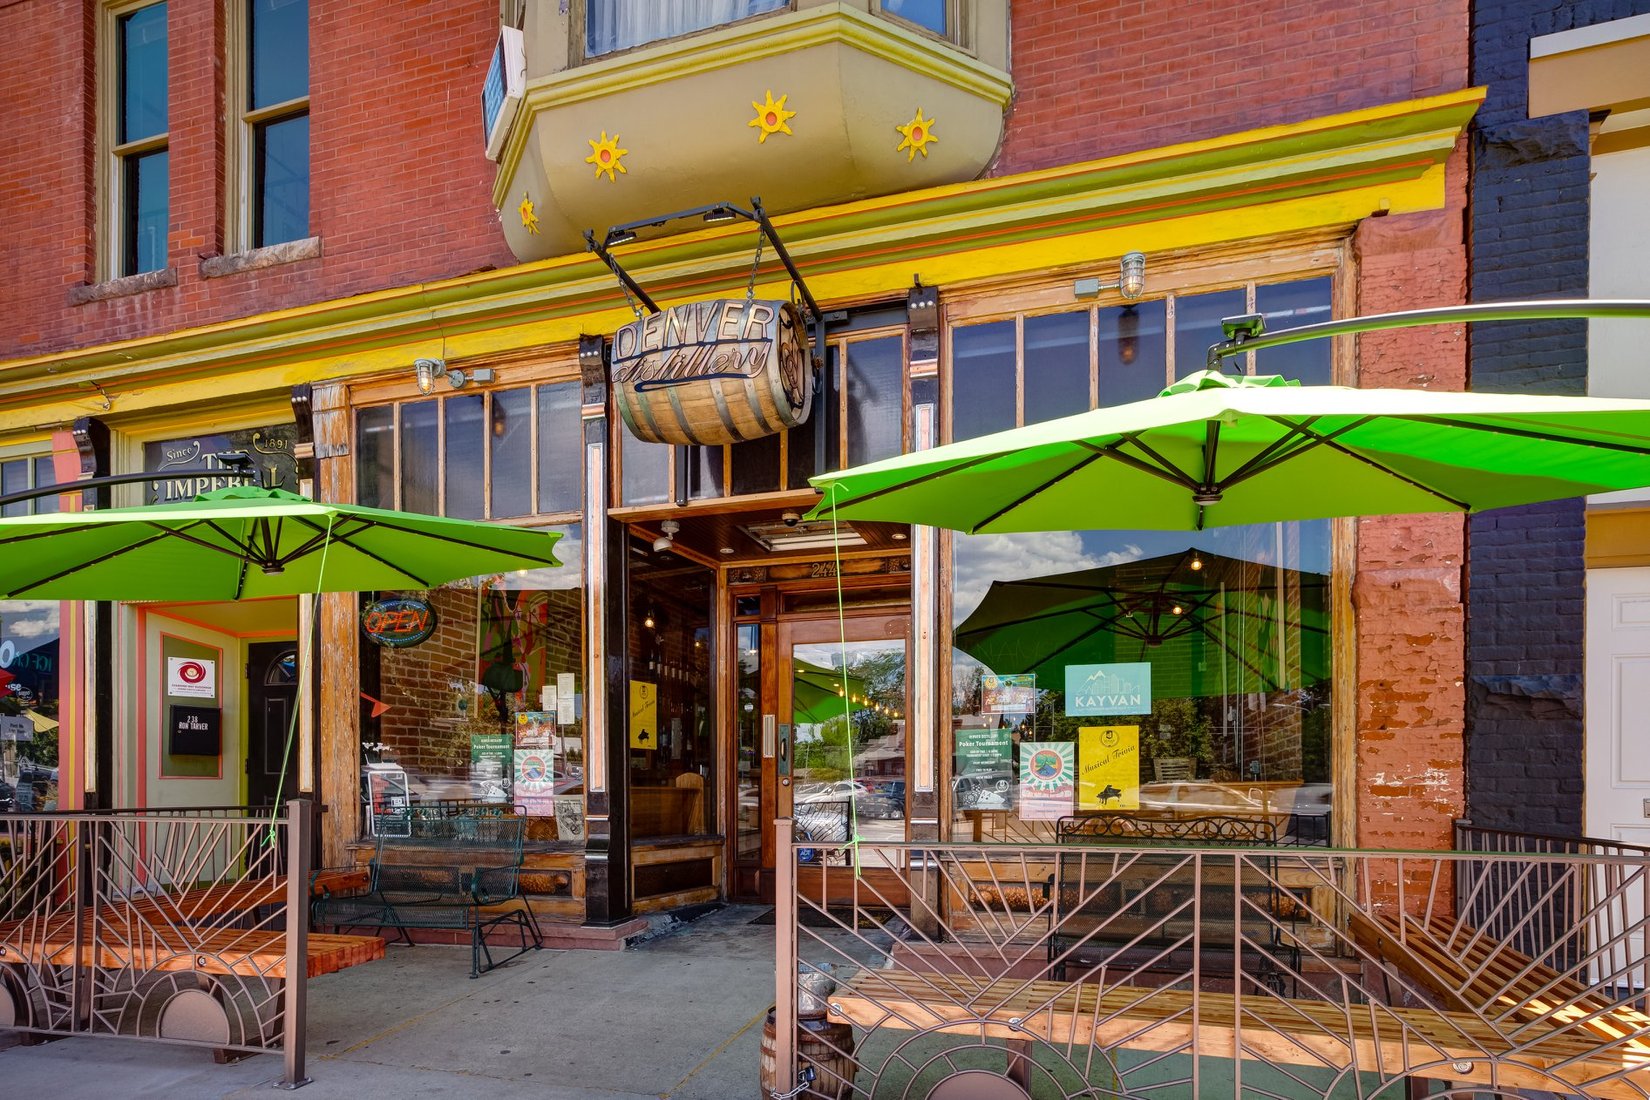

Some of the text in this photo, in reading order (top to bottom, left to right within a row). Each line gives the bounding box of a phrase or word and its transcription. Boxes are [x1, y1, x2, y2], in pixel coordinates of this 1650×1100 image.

[615, 302, 774, 359] DENVER
[611, 341, 772, 383] distillery
[166, 446, 192, 462] Since
[265, 438, 288, 450] 1891
[811, 561, 837, 578] 244
[366, 609, 429, 633] OPEN
[1075, 694, 1141, 708] KAYVAN
[1081, 745, 1136, 775] Musical Trivia
